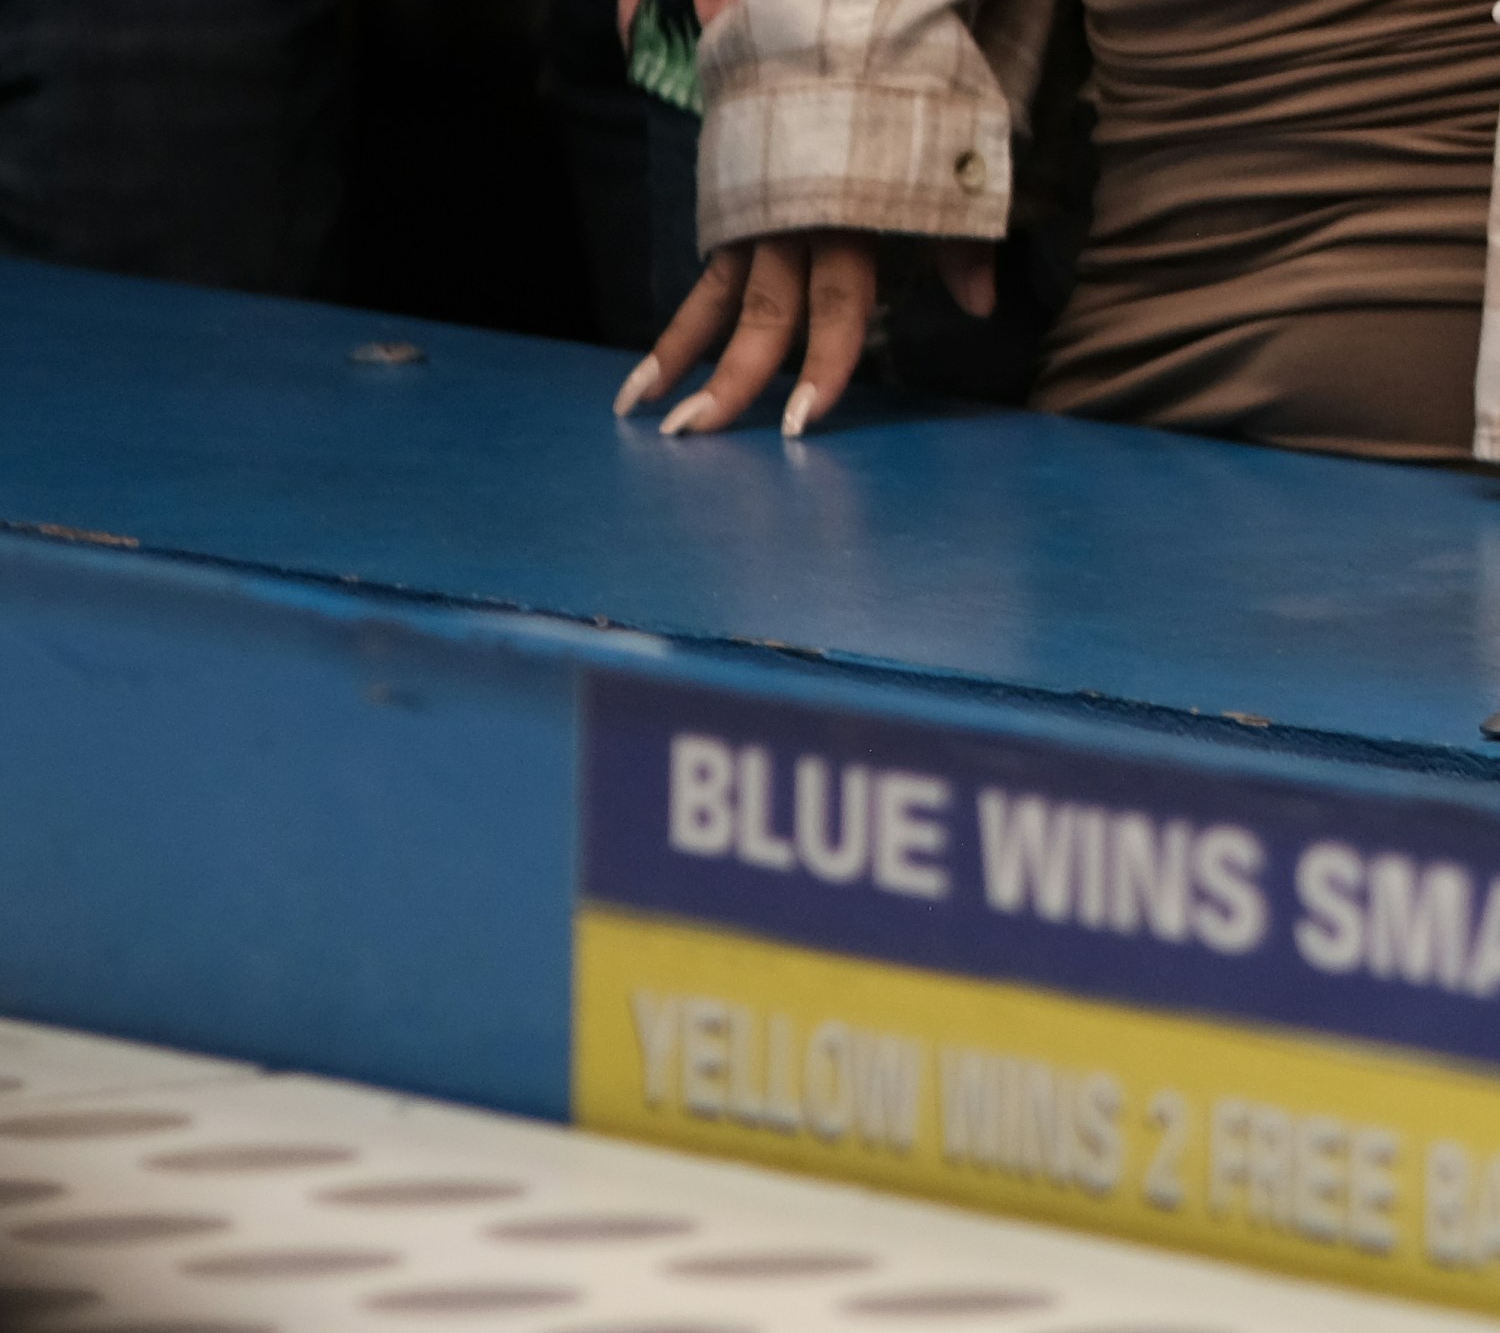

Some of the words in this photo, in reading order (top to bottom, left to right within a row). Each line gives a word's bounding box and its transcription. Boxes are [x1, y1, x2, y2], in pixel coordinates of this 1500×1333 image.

[669, 732, 953, 900] BLUE
[976, 785, 1269, 955] WINS
[630, 989, 921, 1158] YELLOW
[938, 1047, 1127, 1197] WINS
[1142, 1087, 1190, 1212] 2
[1207, 1094, 1401, 1258] FREE
